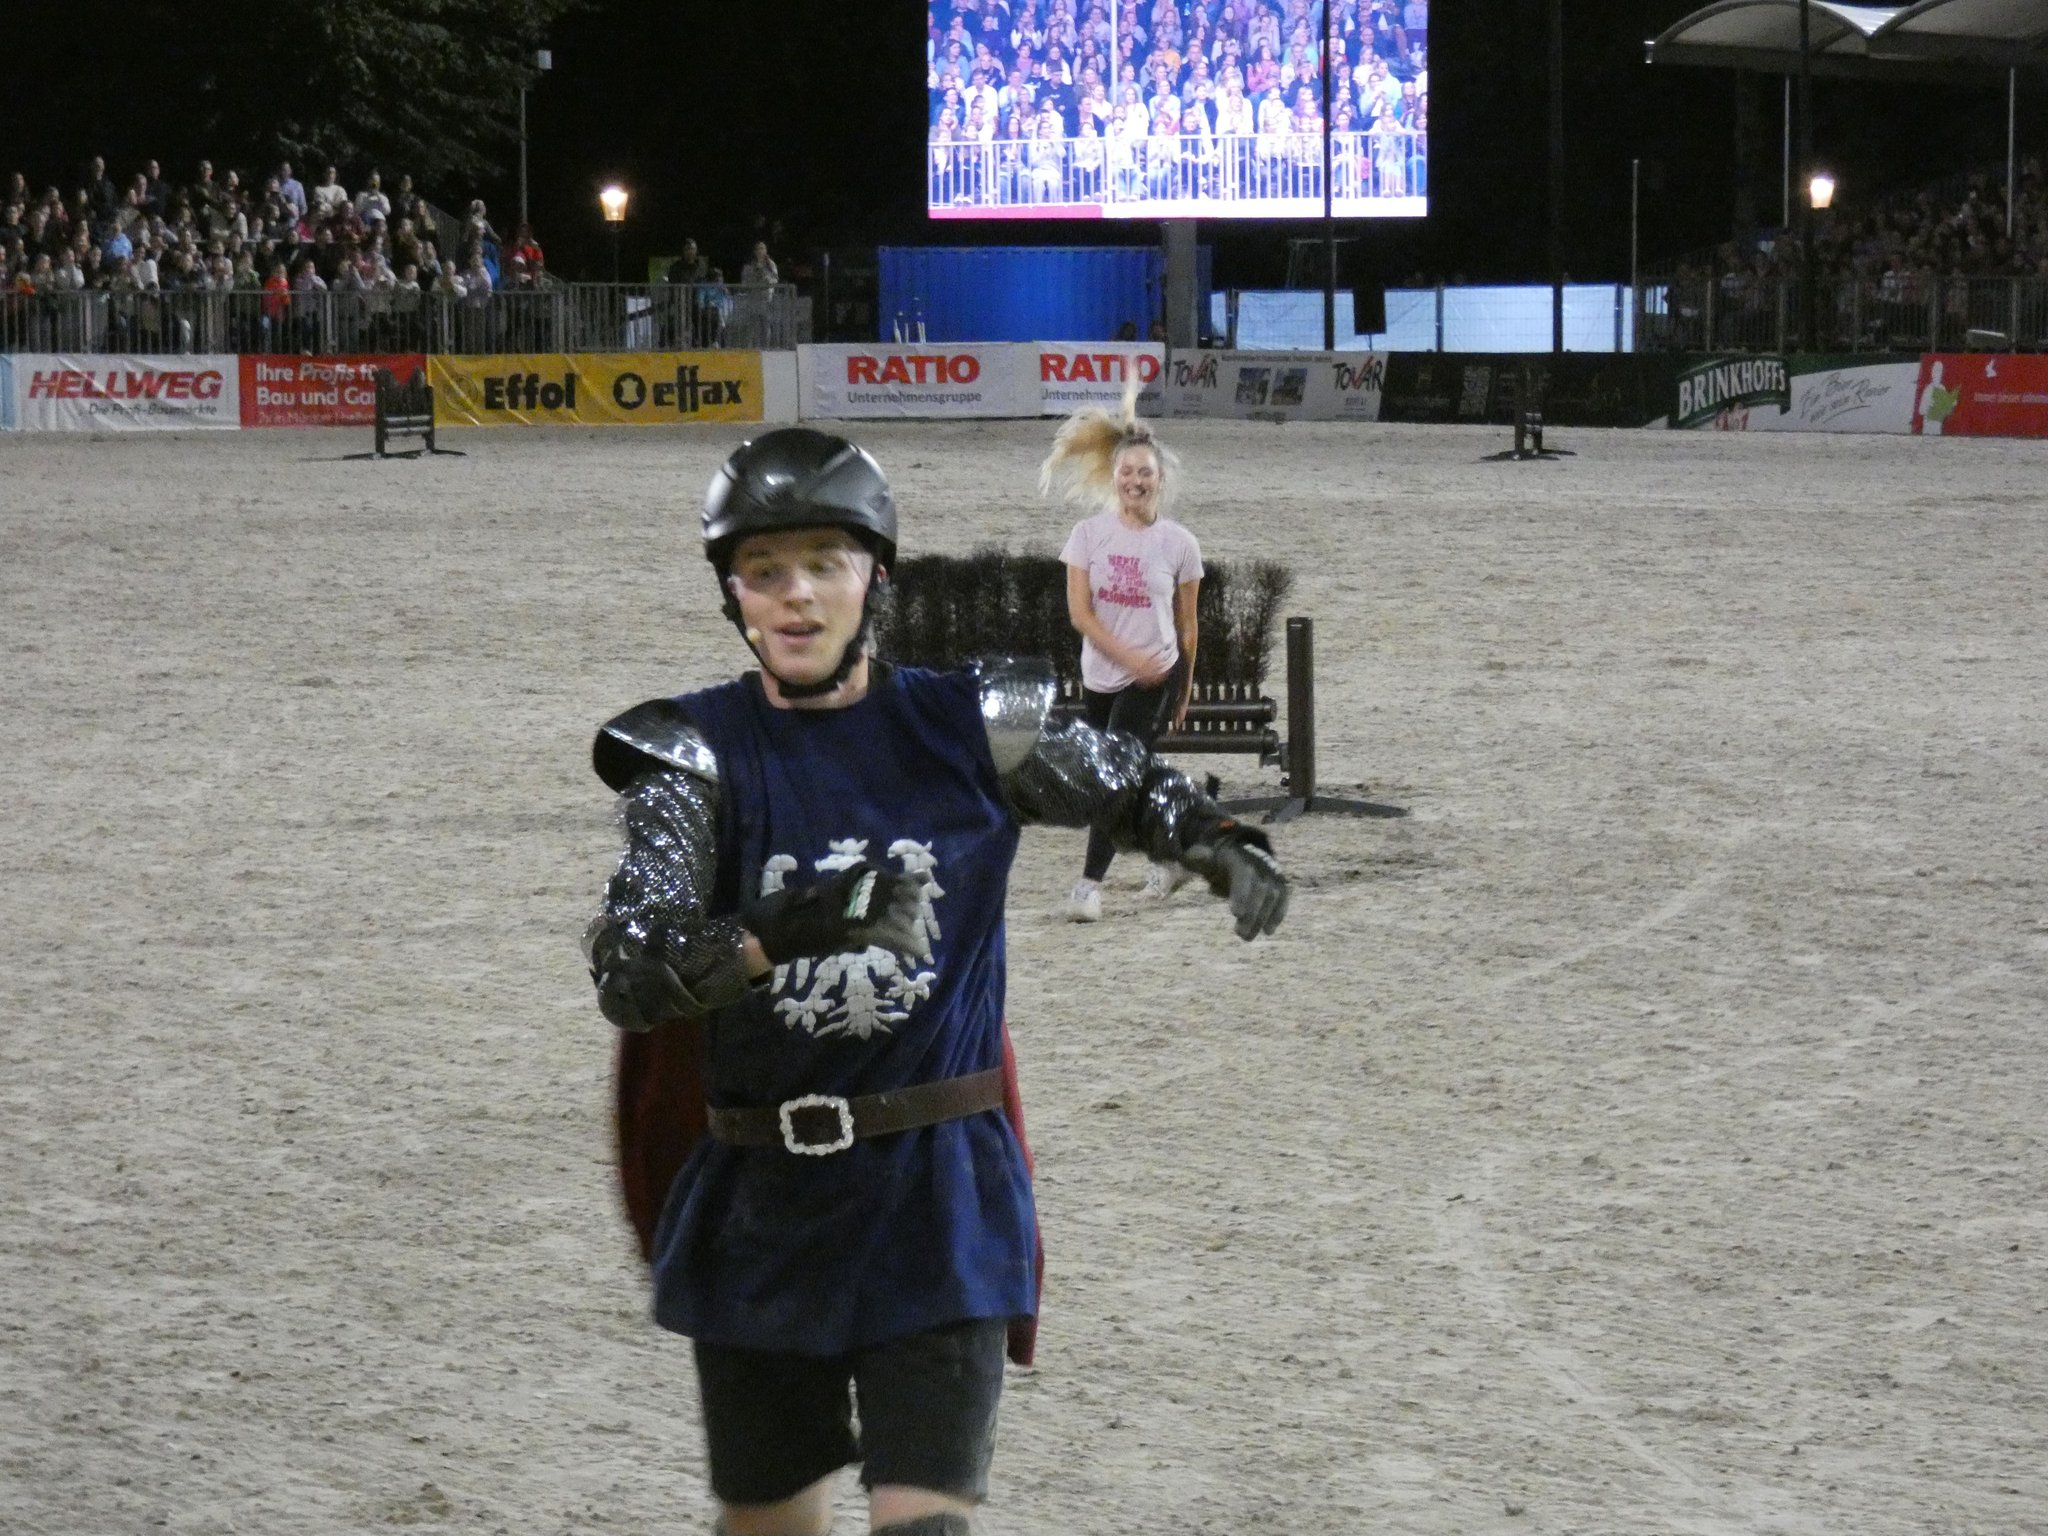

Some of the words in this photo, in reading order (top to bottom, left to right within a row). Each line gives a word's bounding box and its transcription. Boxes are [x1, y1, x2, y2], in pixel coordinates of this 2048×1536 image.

[256, 362, 293, 381] Ihre
[299, 362, 355, 385] Profis
[847, 355, 980, 384] RATIO
[1040, 354, 1161, 382] RATIO
[1332, 356, 1385, 392] TOVAR
[29, 370, 223, 399] HELLWEG
[256, 387, 294, 405] Bau
[302, 388, 338, 405] und
[484, 371, 576, 409] Effol
[652, 365, 742, 412] effax
[848, 390, 982, 403] Unternehmensgruppe
